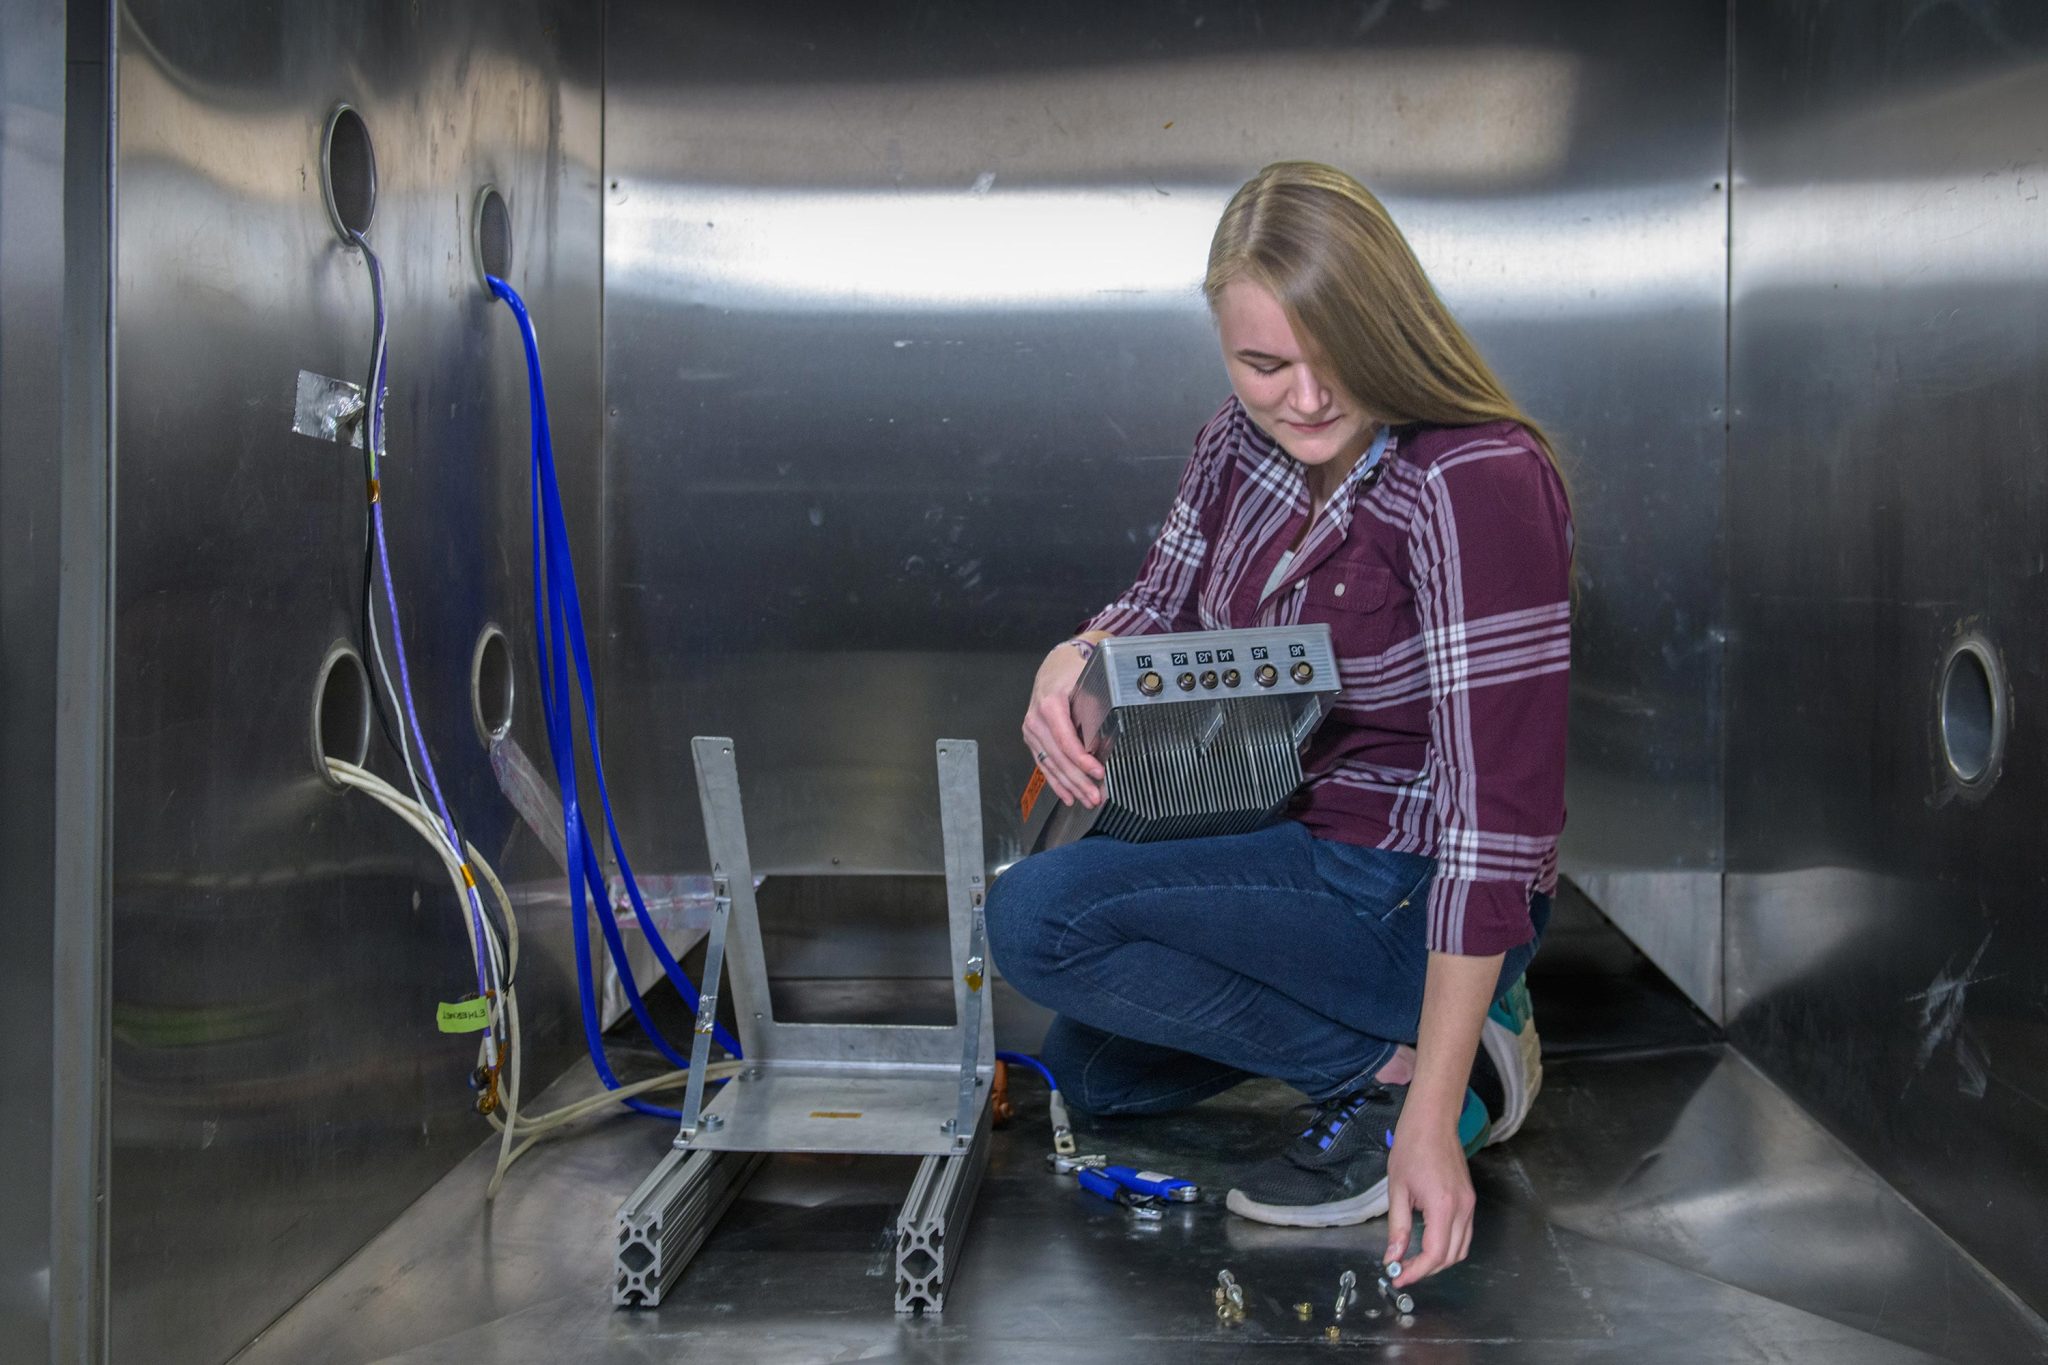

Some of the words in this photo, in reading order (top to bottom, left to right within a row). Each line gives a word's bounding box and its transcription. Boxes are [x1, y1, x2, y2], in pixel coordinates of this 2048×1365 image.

[1197, 651, 1212, 663] J3
[1218, 650, 1233, 661] J4
[1252, 648, 1267, 659] J5
[1290, 645, 1304, 657] J6
[1139, 656, 1152, 668] J1
[1172, 653, 1187, 665] J2
[715, 901, 724, 914] A
[442, 1009, 486, 1020] ETHERNET
